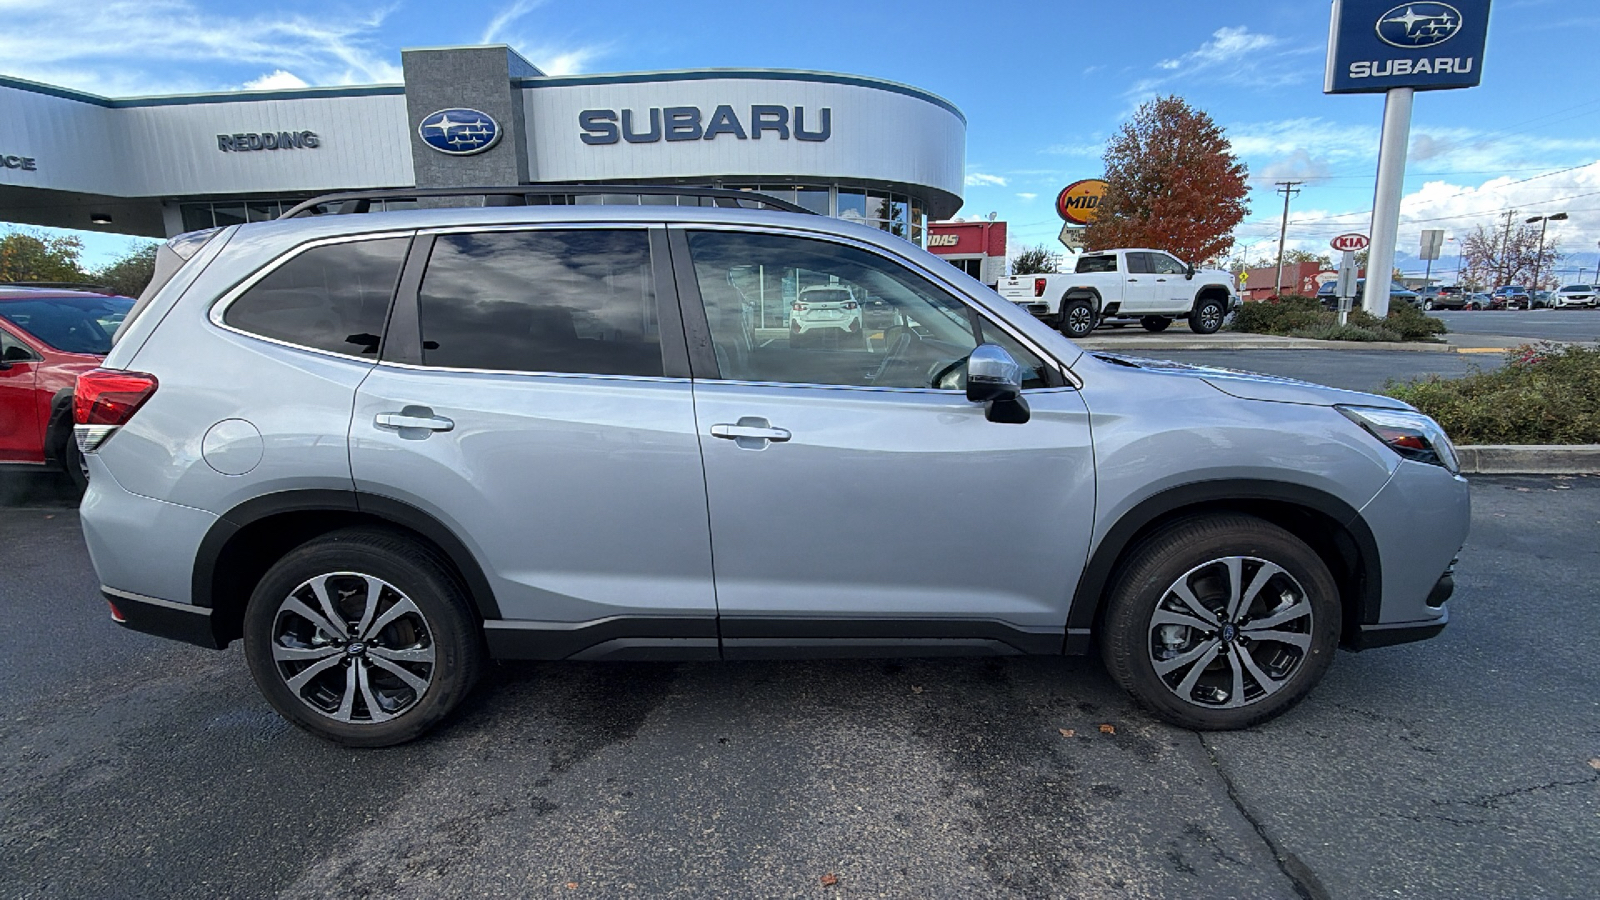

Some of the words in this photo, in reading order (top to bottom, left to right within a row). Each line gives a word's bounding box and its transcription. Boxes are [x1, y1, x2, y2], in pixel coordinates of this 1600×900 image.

[1349, 57, 1473, 78] SUBARU
[579, 104, 831, 145] SUBARU
[216, 131, 319, 152] REDDING
[1065, 190, 1106, 209] MIDA
[927, 230, 959, 247] IDAS
[1339, 237, 1364, 248] KIA
